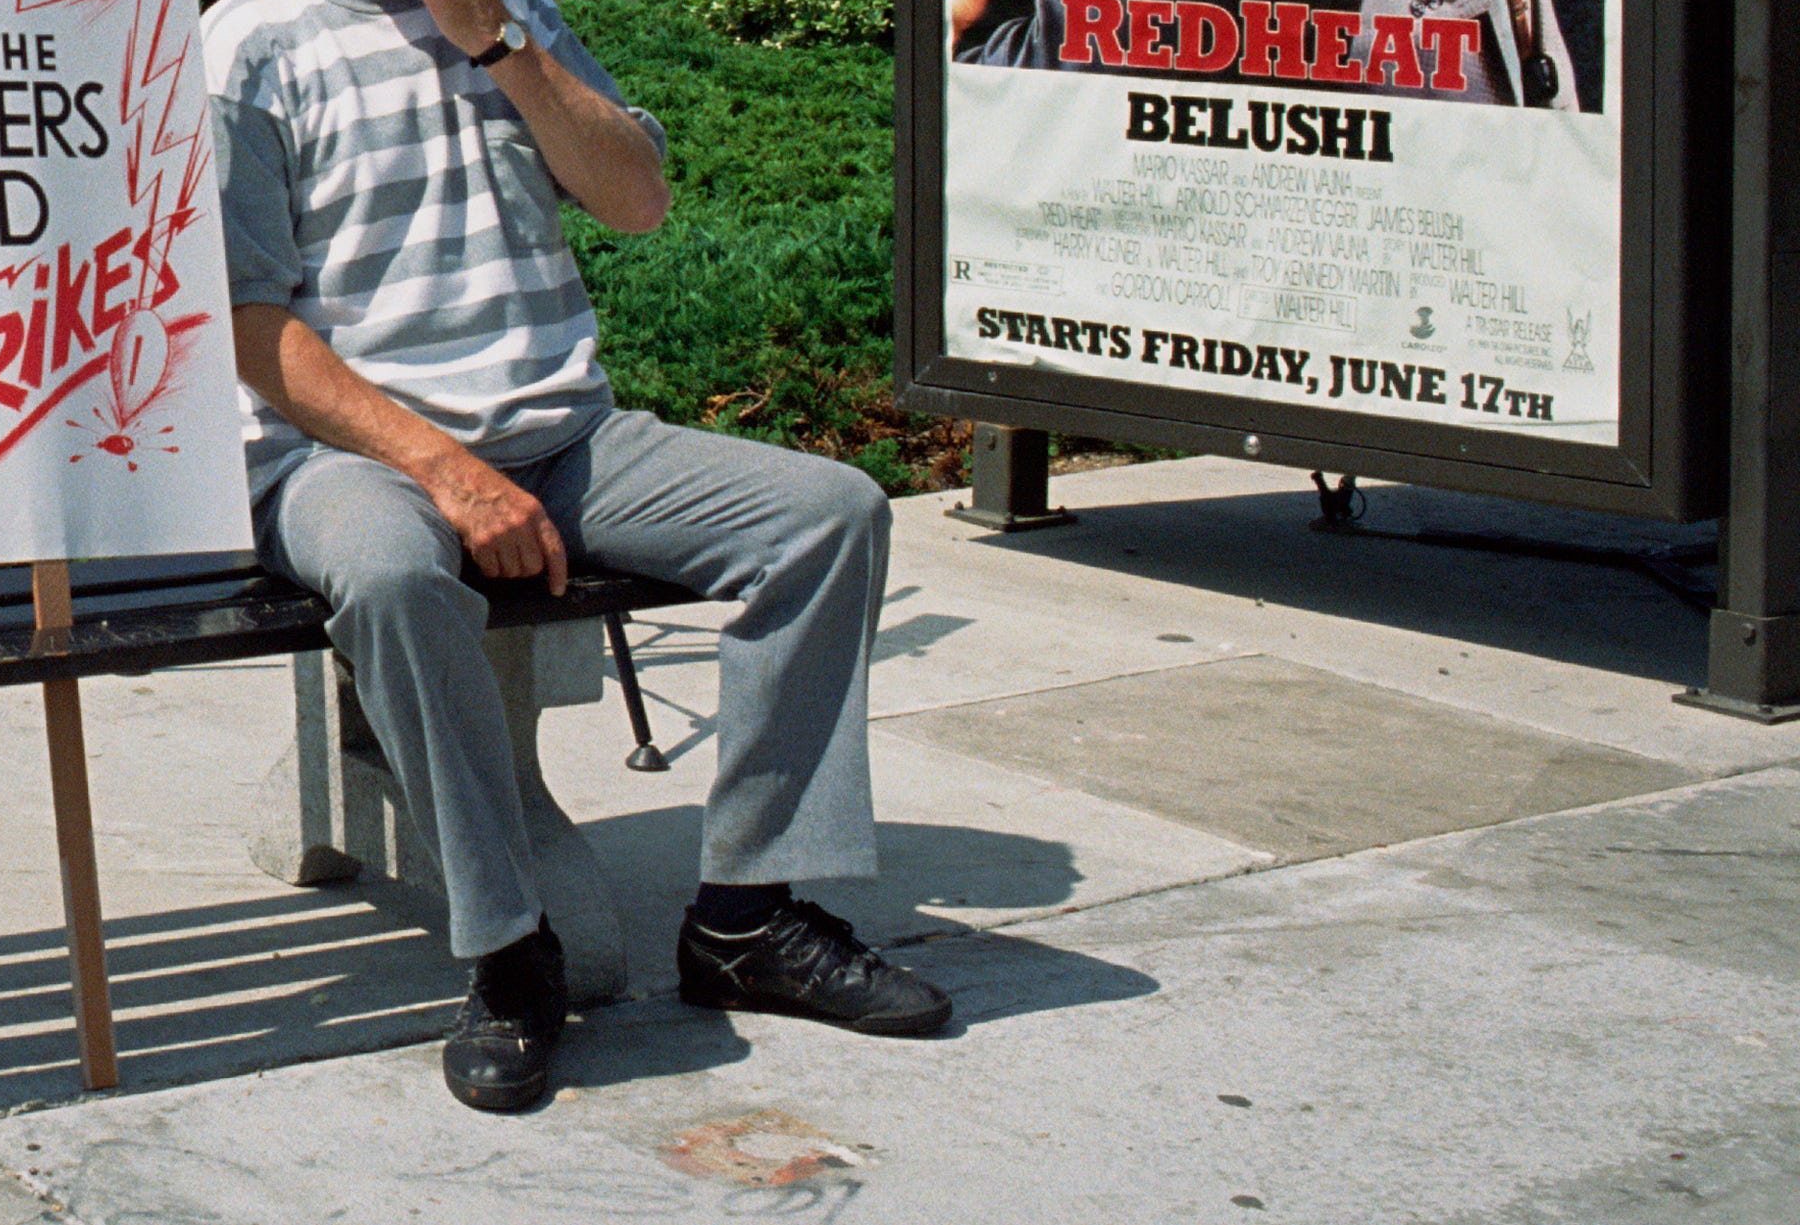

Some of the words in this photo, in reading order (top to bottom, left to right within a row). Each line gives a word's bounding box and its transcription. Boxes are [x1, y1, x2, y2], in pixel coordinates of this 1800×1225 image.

[1125, 91, 1394, 162] BELUSHI
[1133, 153, 1177, 179] MARIO
[1181, 157, 1229, 185] KASSAR
[1252, 163, 1309, 192] ANDREW
[1176, 187, 1230, 216] ARNOLD
[1234, 190, 1358, 229] SCHWARZENEGGER
[1367, 206, 1415, 234] JAMES
[1418, 209, 1463, 241] BELUSHI
[954, 260, 972, 280] R
[1409, 241, 1458, 272] WALTER
[1460, 247, 1485, 276] HILL
[1112, 272, 1172, 302] GORDON
[1450, 278, 1497, 309] WALTER
[1502, 284, 1528, 314] HILL
[1273, 292, 1326, 323] WALTER
[1513, 320, 1552, 343] RELEASE
[977, 306, 1132, 360] STARTS
[1140, 329, 1320, 396] FRIDAY,
[1328, 354, 1446, 405] JUNE
[1460, 372, 1555, 421] 17TH
